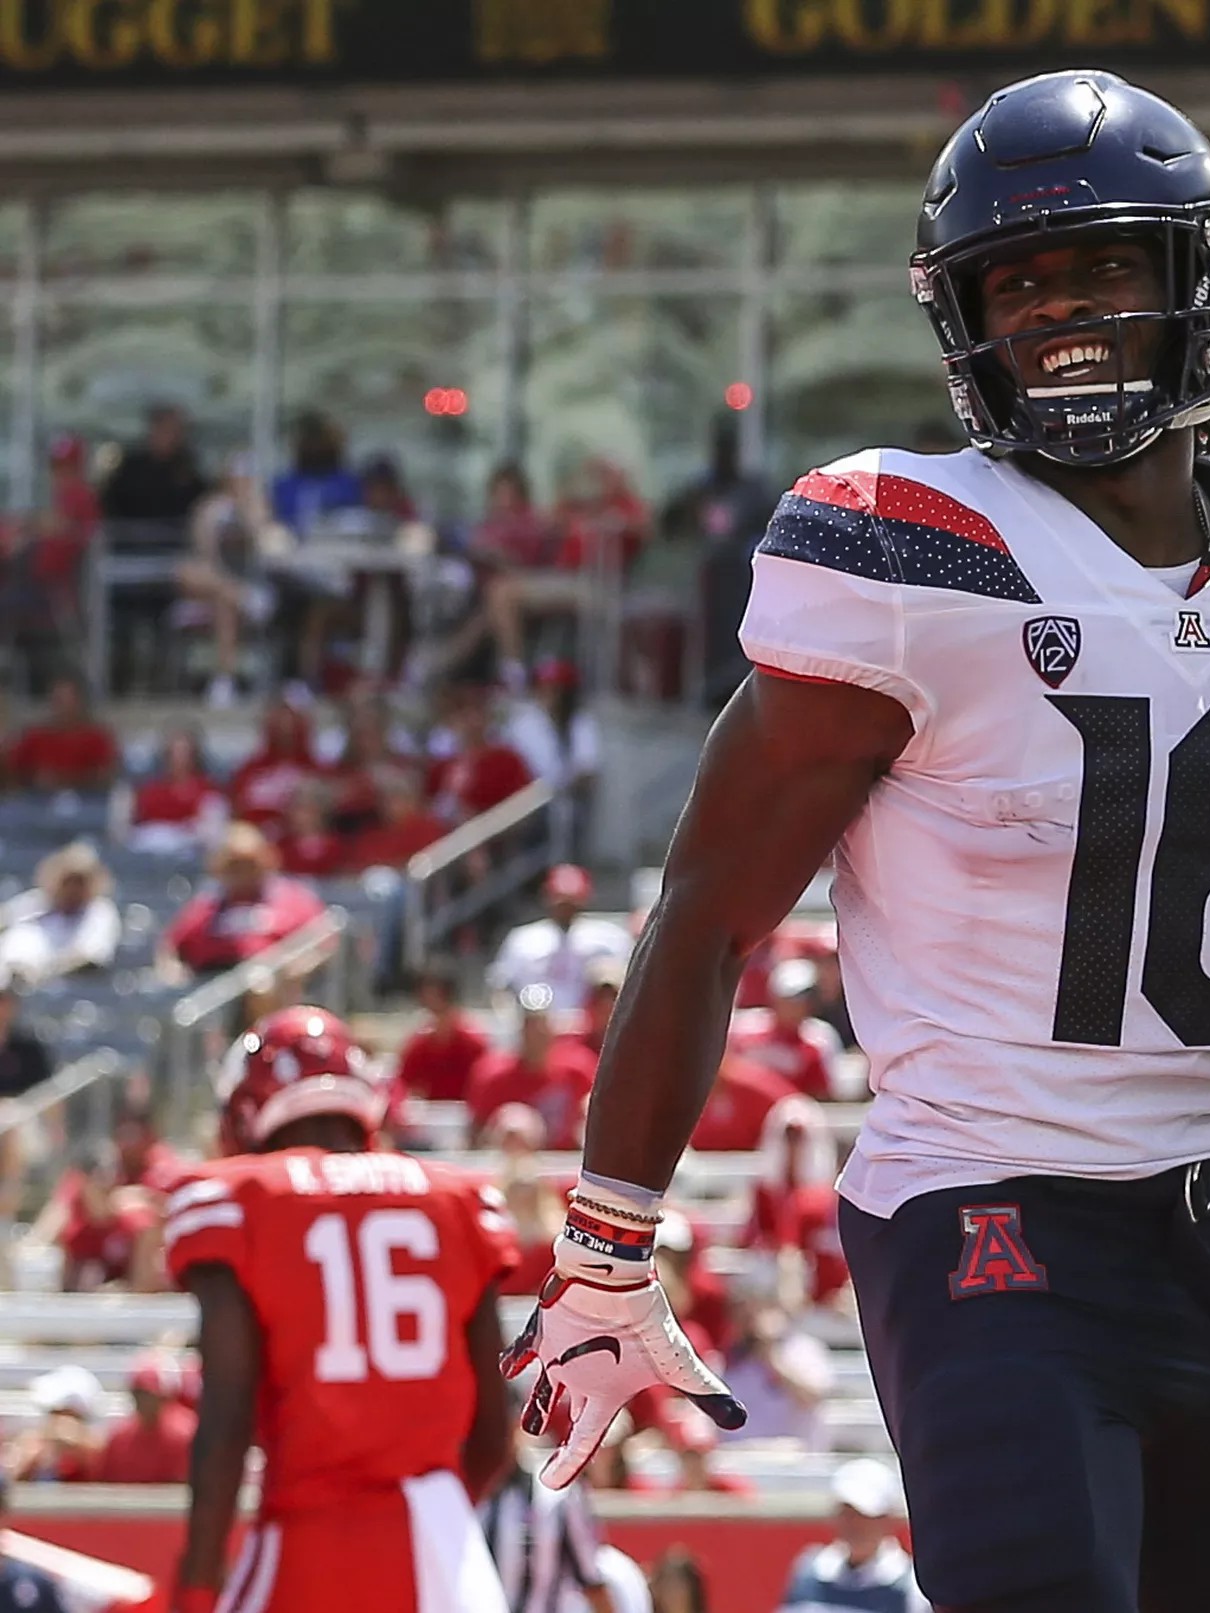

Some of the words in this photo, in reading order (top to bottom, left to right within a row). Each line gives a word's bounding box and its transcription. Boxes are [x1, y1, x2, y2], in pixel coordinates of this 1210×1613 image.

[1028, 618, 1077, 660] PAC
[1175, 611, 1210, 648] A
[1040, 646, 1067, 672] 12
[948, 1203, 1048, 1301] A
[305, 1209, 447, 1383] 16
